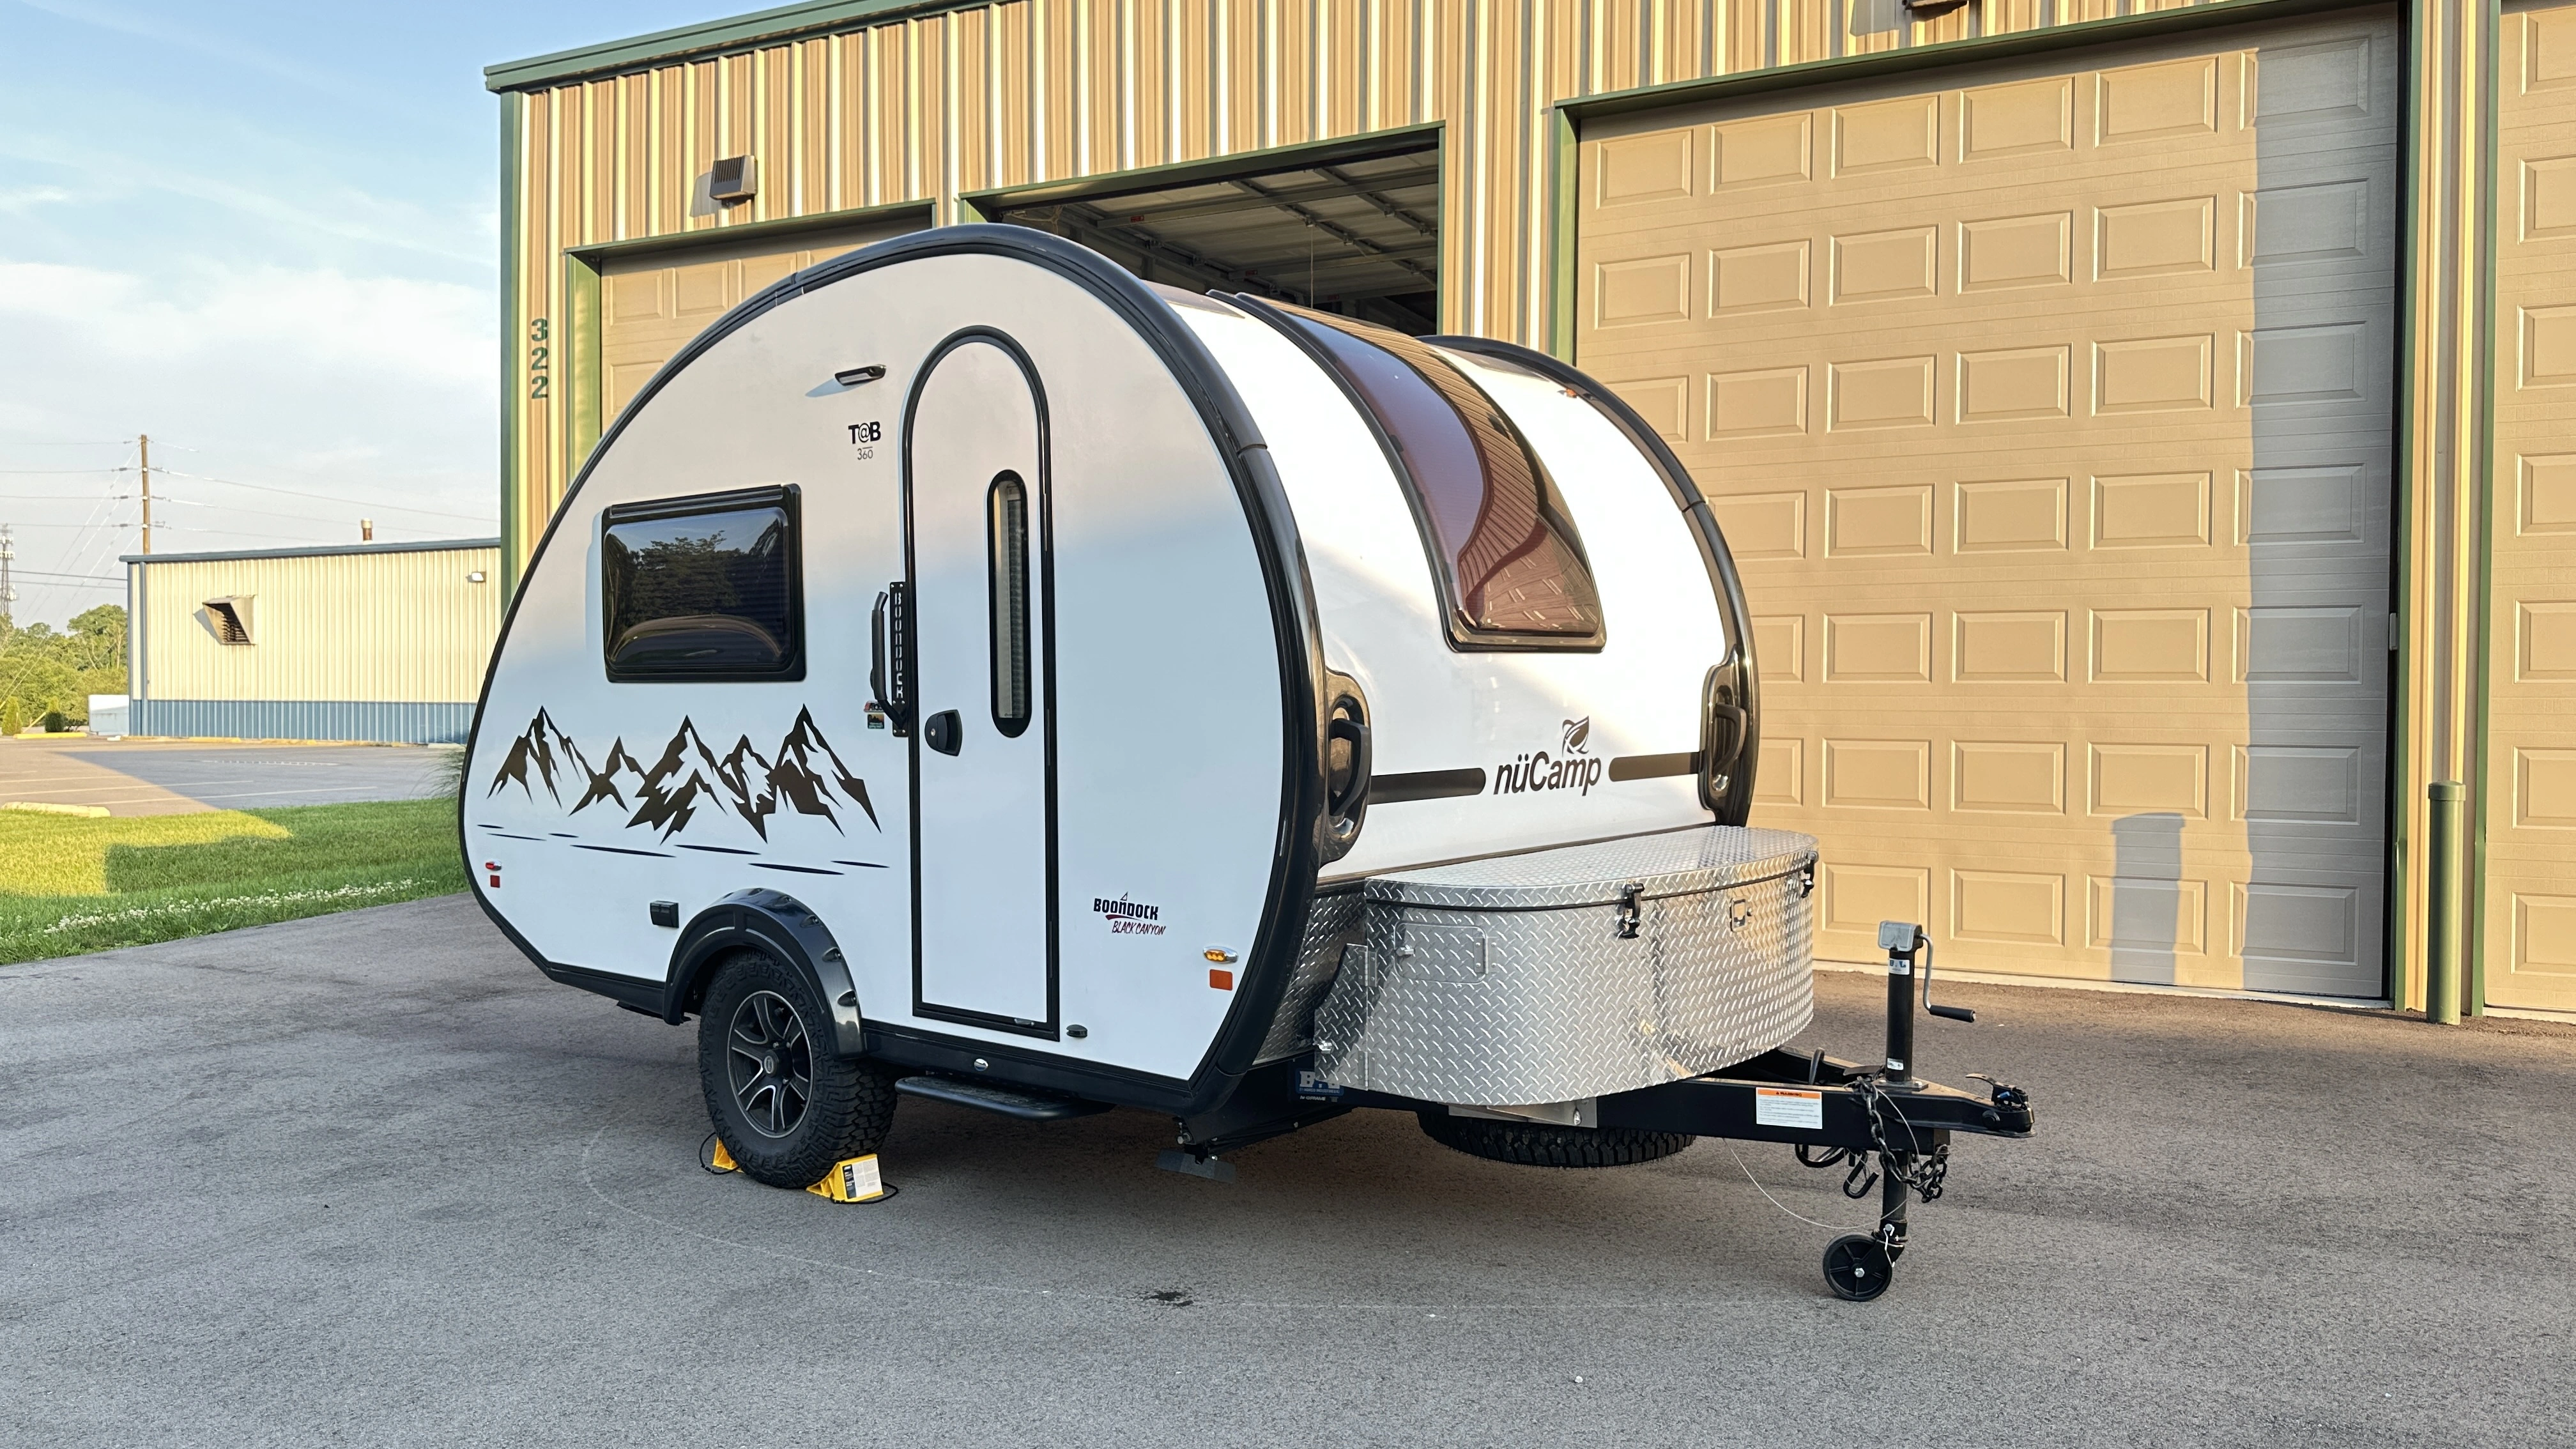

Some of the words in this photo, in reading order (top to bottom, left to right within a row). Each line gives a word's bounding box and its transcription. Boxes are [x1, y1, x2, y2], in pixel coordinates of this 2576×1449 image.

[531, 318, 548, 399] 322
[848, 421, 881, 444] T@B
[857, 447, 873, 460] 360
[1493, 751, 1602, 796] nüCamp
[1112, 920, 1136, 934] BLACK
[1135, 923, 1167, 936] CANYON
